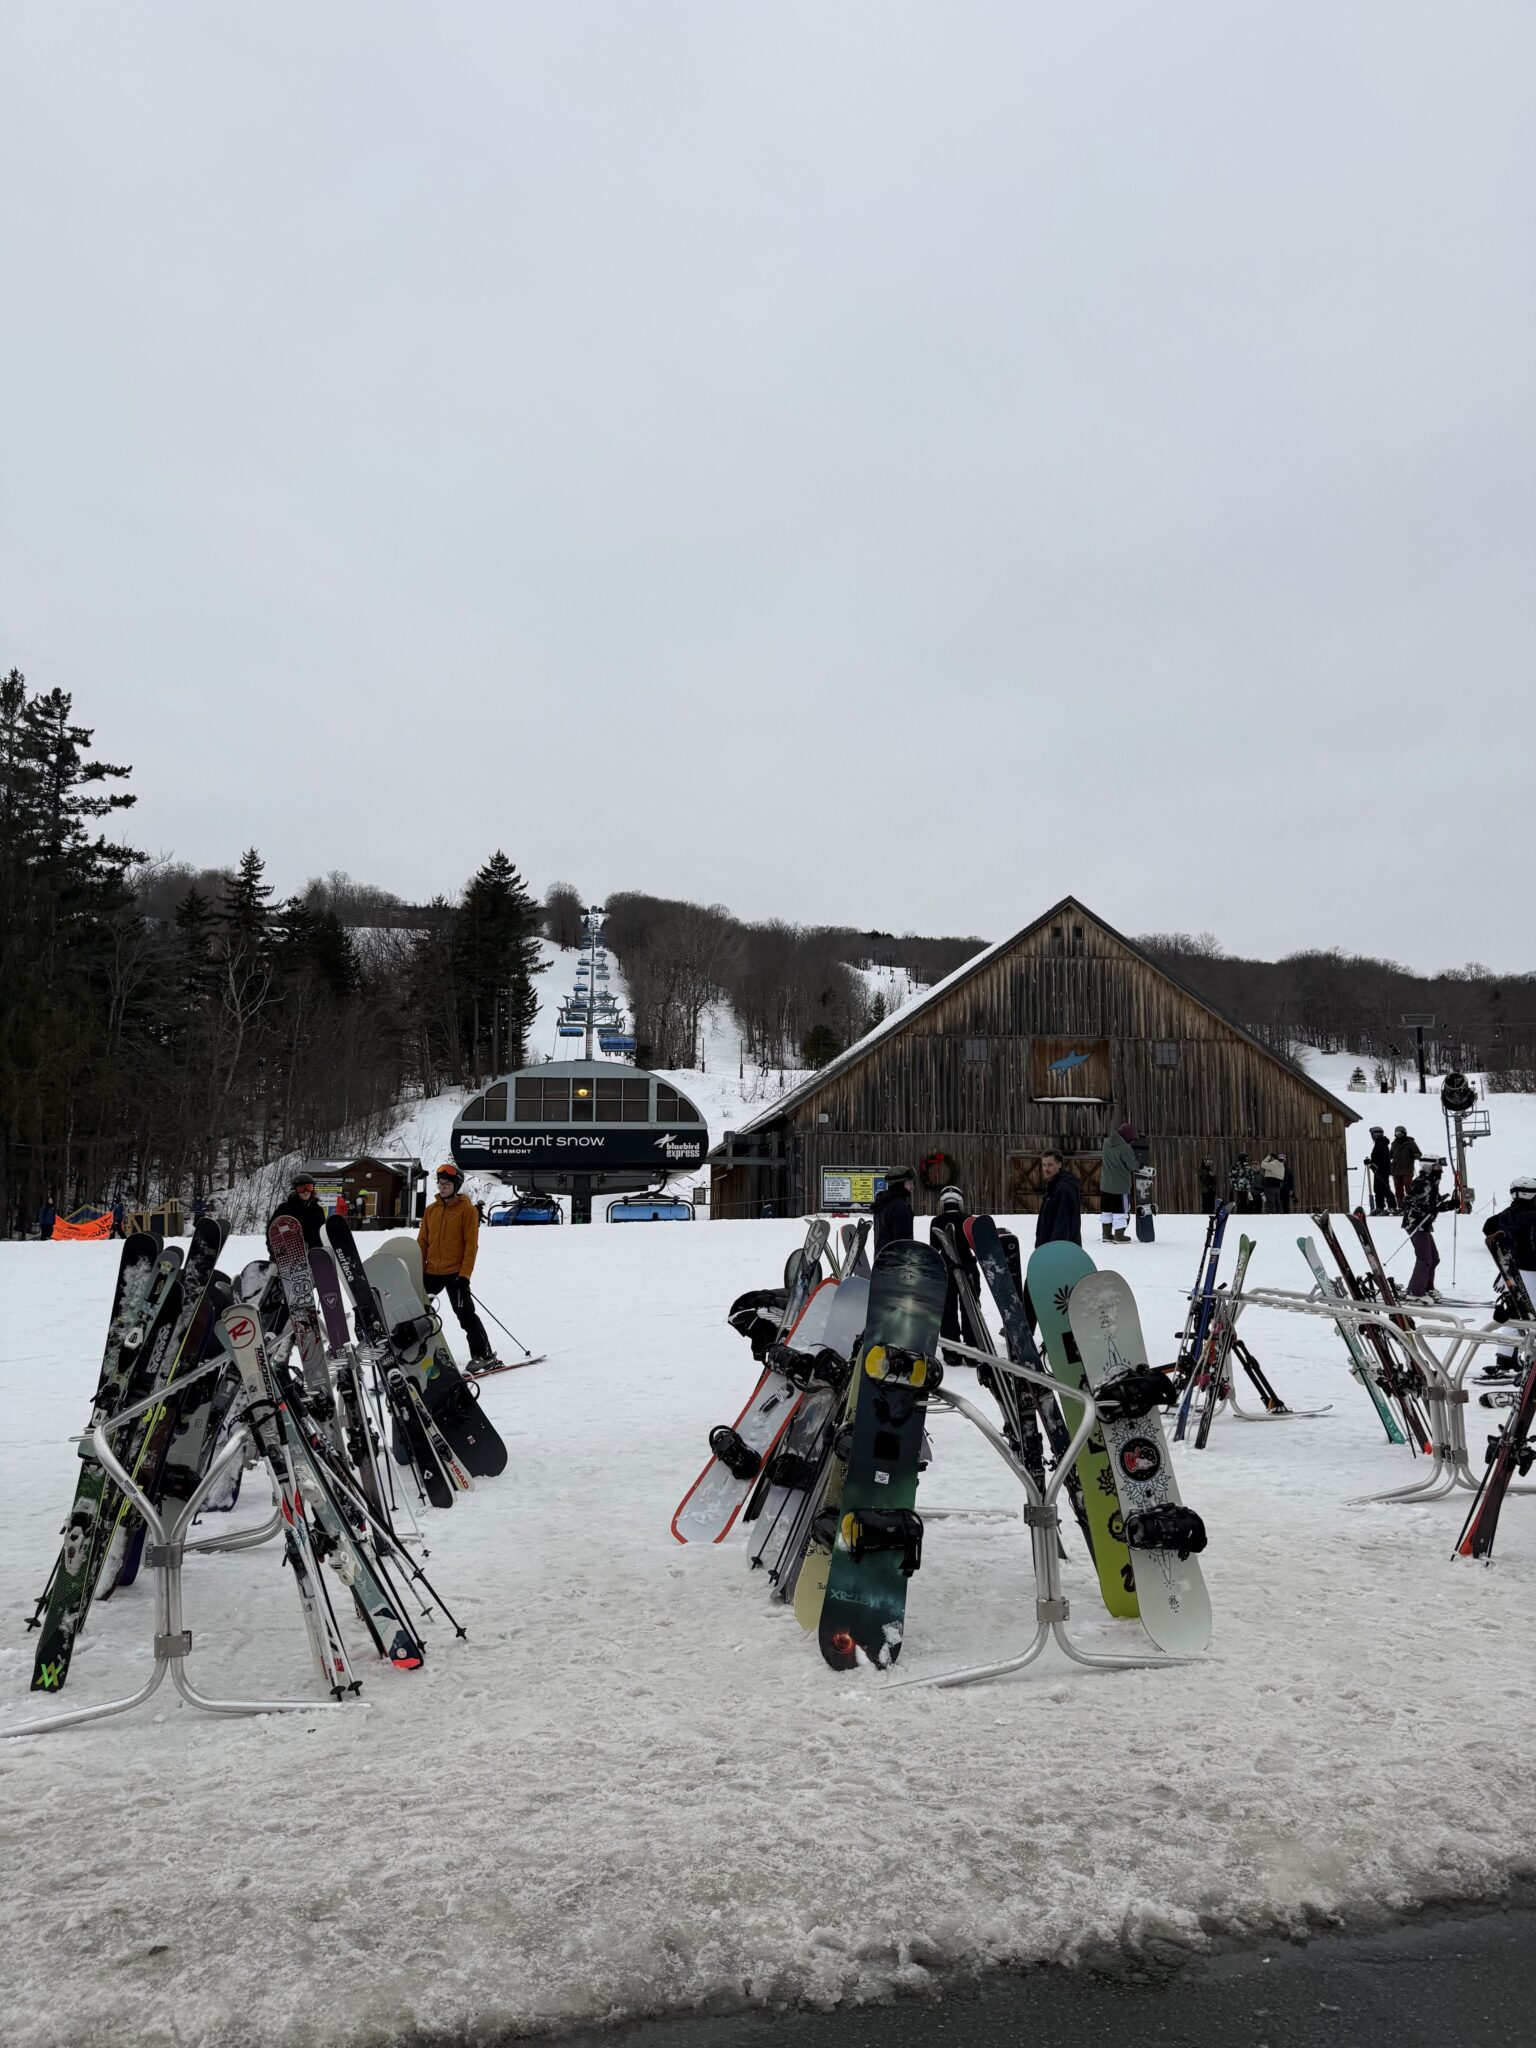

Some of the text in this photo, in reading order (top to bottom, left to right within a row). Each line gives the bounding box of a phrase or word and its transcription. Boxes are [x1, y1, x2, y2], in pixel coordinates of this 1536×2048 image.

[491, 1134, 604, 1147] mount snow
[666, 1142, 700, 1150] bluebird
[666, 1149, 700, 1160] express
[335, 1248, 354, 1281] surface
[256, 1344, 274, 1401] OSSIGNOL
[450, 1460, 469, 1489] HEAD
